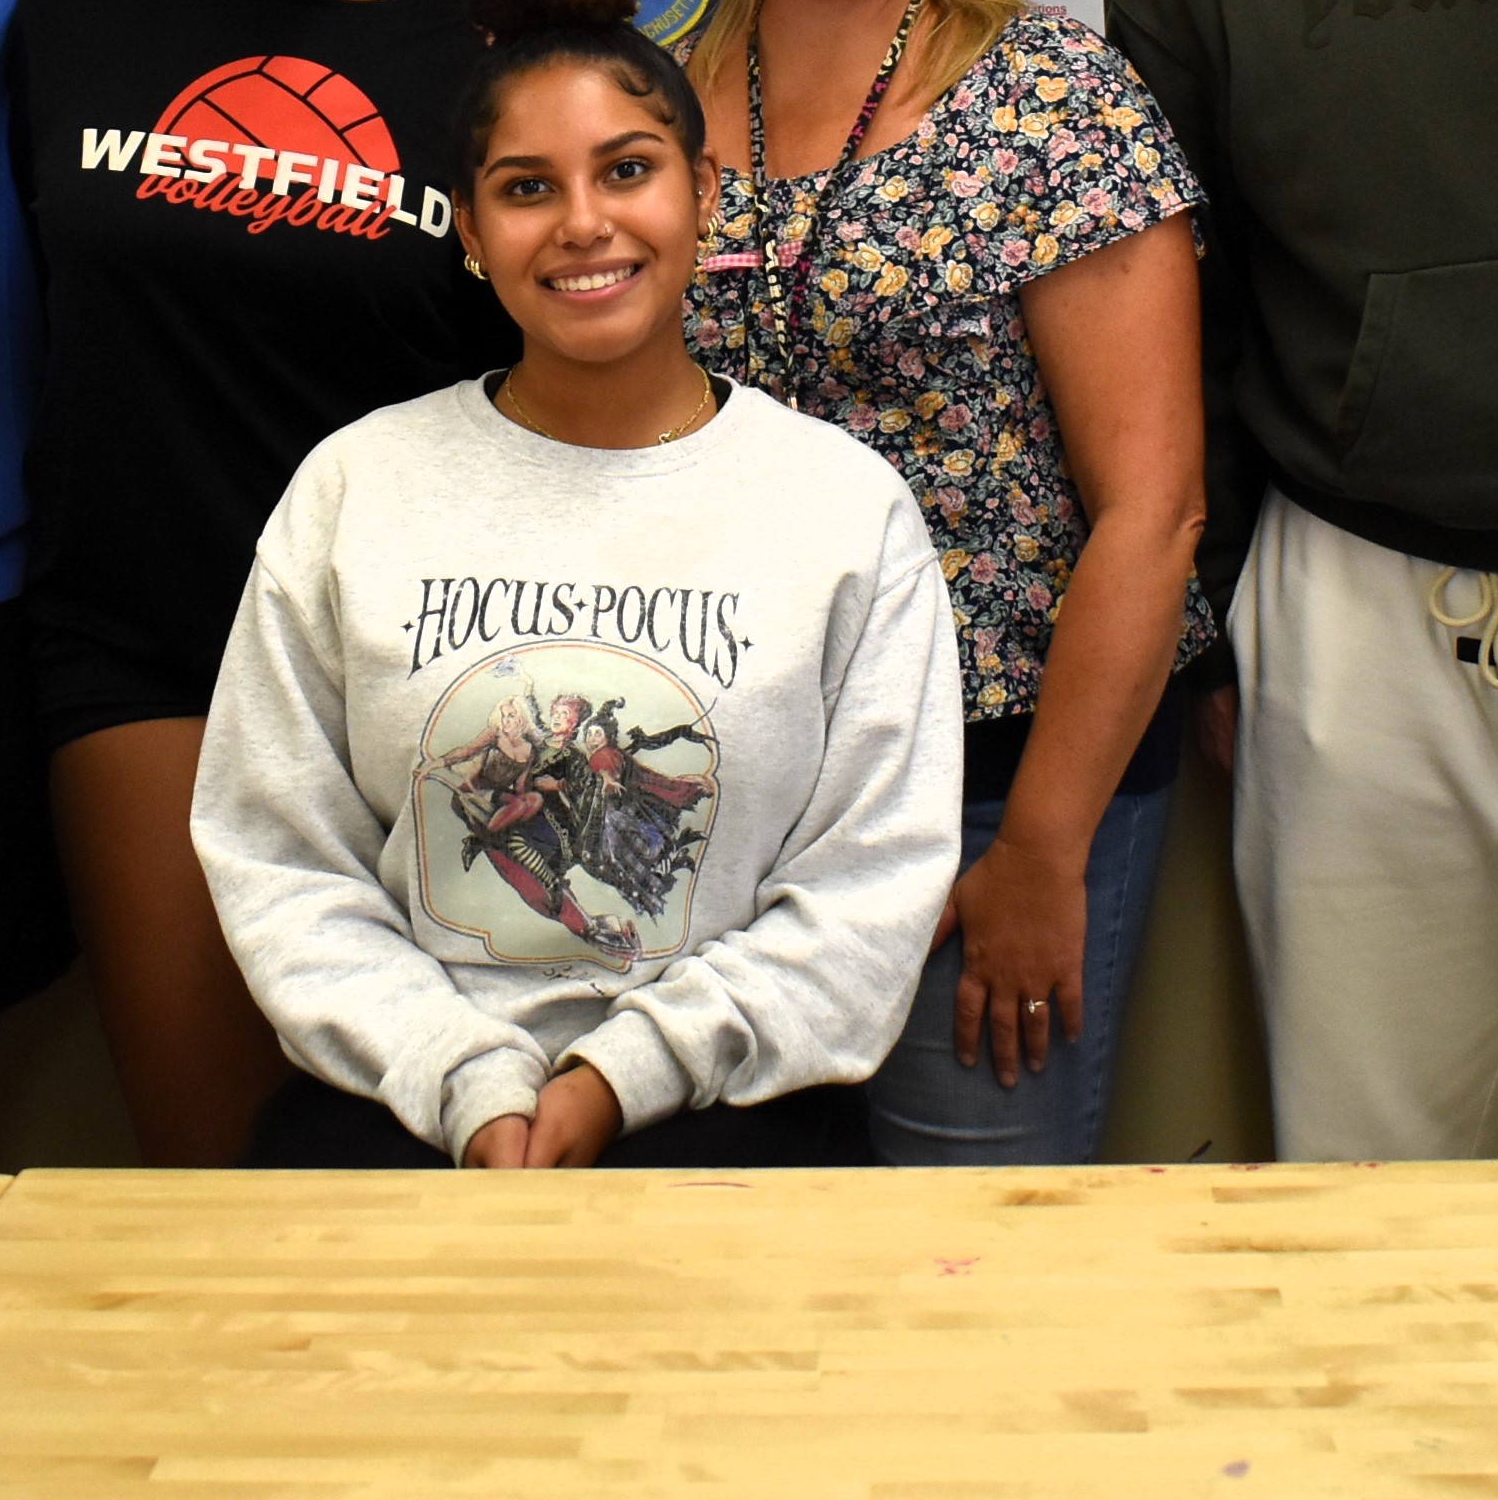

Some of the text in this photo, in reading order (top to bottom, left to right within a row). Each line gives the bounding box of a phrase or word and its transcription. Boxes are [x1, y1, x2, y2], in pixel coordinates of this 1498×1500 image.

[81, 128, 452, 238] WESTFIELD
[135, 173, 395, 240] volleyball
[408, 577, 739, 688] HOCUS POCUS
